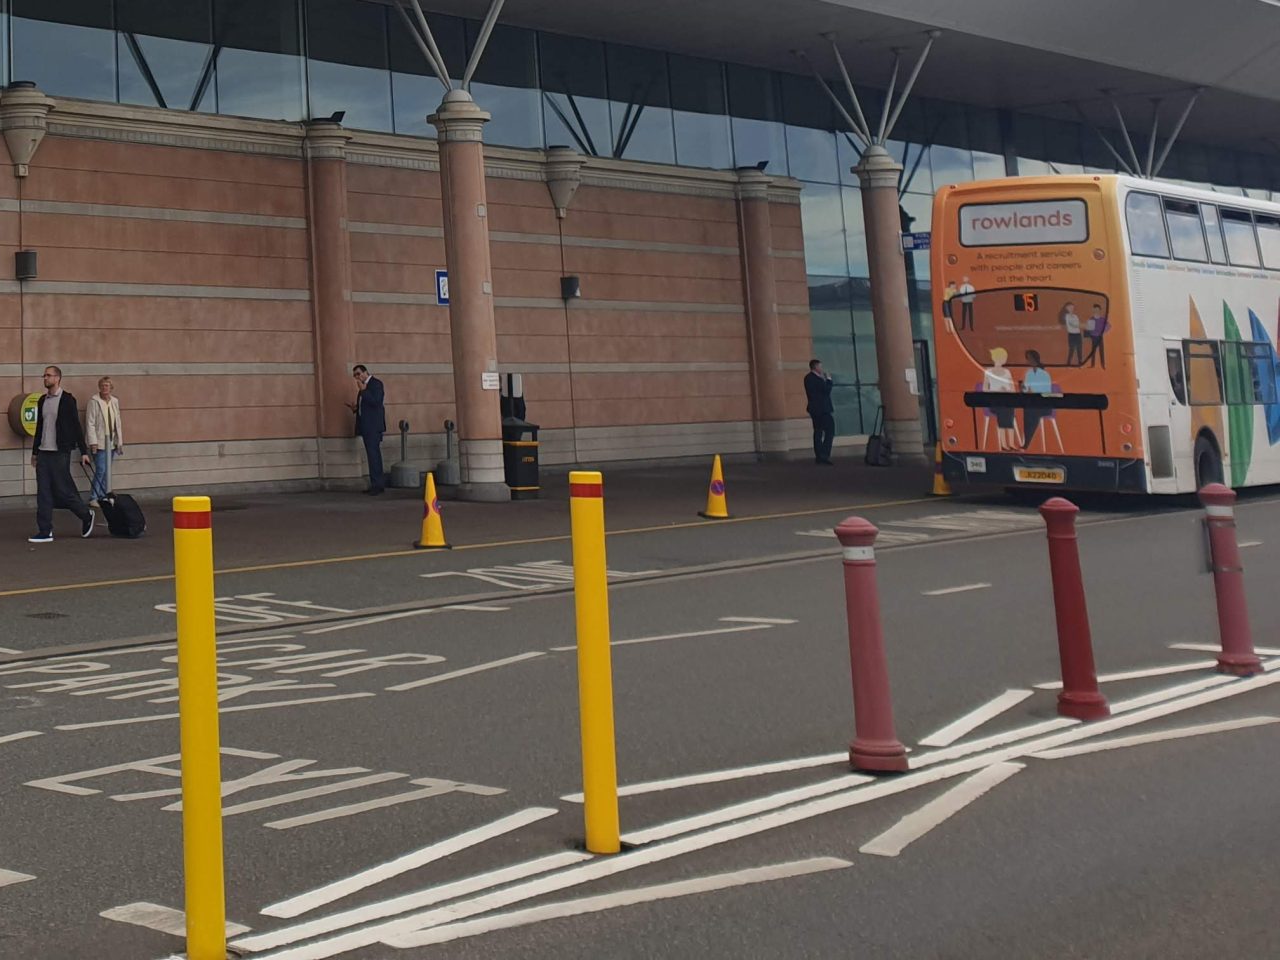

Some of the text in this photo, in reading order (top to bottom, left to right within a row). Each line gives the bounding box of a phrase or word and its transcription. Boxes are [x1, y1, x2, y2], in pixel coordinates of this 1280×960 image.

[972, 210, 1073, 231] rowlands
[985, 251, 1038, 260] recruitment
[1040, 250, 1073, 258] service
[970, 261, 1082, 273] with people and careers
[1009, 274, 1024, 283] the
[1026, 274, 1052, 283] heart
[154, 592, 354, 624] OFF
[22, 746, 508, 831] EXIT
